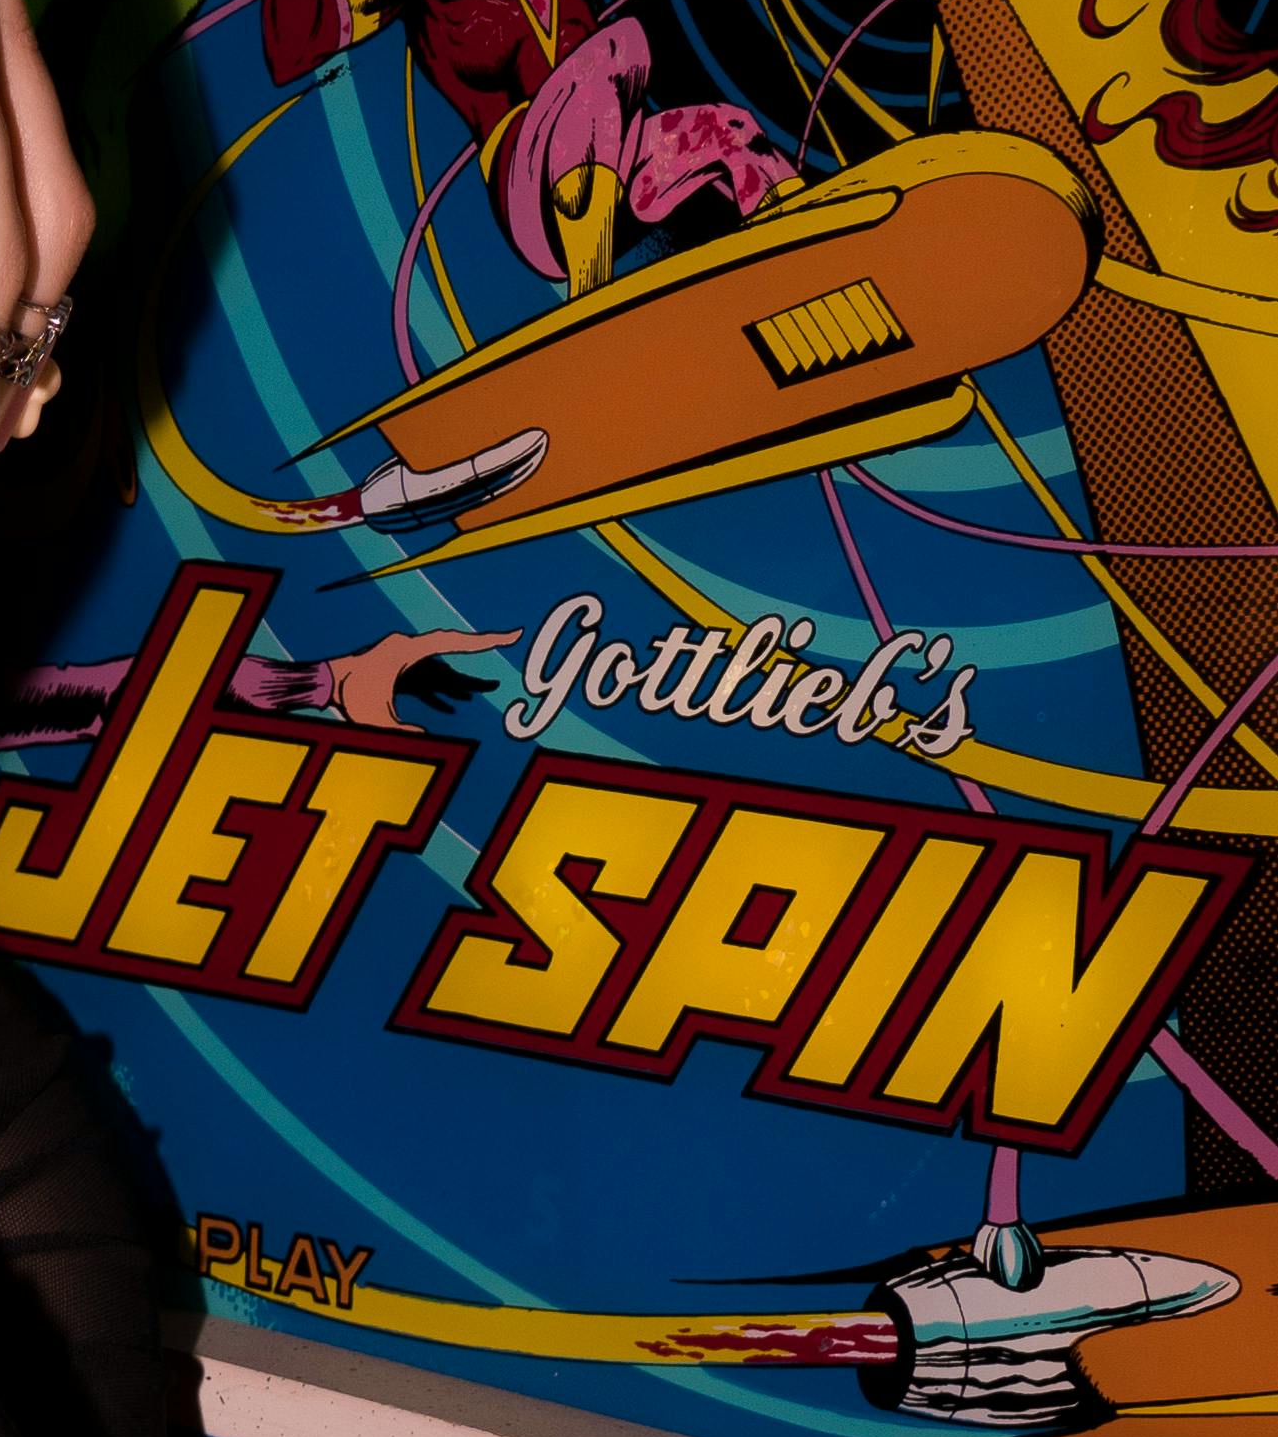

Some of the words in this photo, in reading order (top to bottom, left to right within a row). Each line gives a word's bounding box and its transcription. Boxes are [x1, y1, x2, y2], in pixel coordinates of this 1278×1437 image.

[503, 593, 981, 759] Gottlieb's
[424, 779, 1212, 1129] SPIN
[196, 1212, 374, 1310] PLAY
